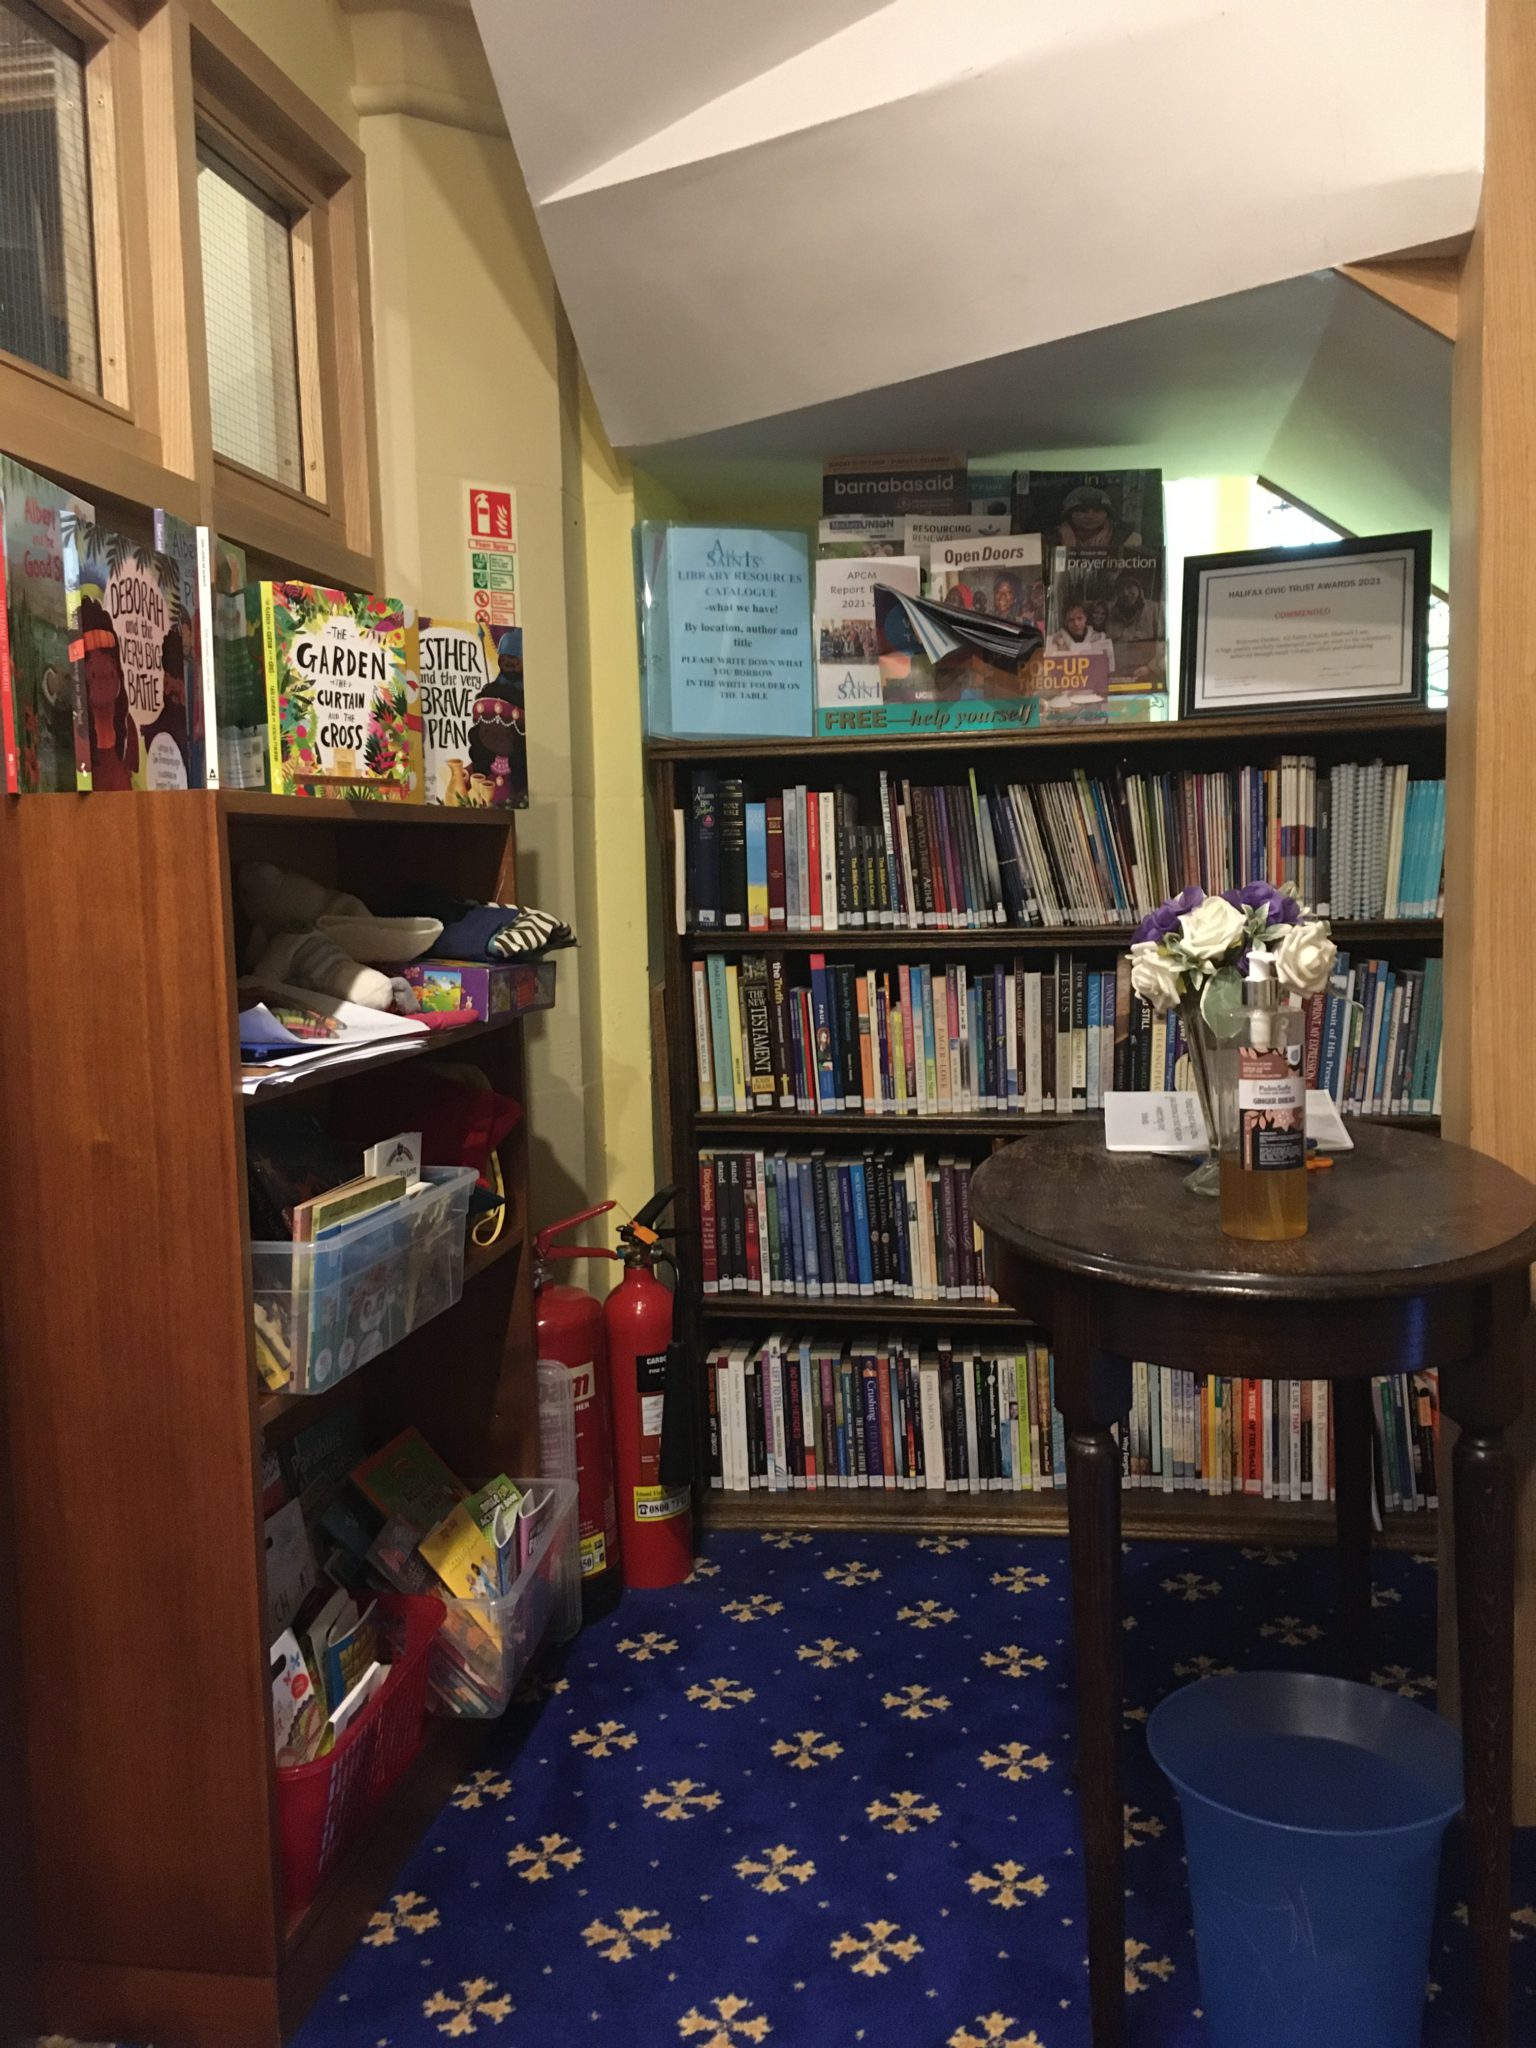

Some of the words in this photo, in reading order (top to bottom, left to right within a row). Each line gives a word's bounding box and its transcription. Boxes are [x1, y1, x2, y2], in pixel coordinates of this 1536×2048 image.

[913, 524, 971, 533] RESOURCING
[945, 549, 980, 566] Open
[982, 546, 1024, 561] Doors
[678, 571, 729, 581] LIBRARY
[734, 571, 802, 584] RESOURCES
[847, 572, 877, 580] APCM
[705, 587, 778, 598] CATALOGUE
[830, 586, 865, 595] Report
[1228, 588, 1263, 599] HALIFAX
[1264, 586, 1286, 595] CIVIC
[1289, 583, 1315, 593] TRUST
[1317, 580, 1356, 591] AWARDS
[1358, 577, 1381, 586] 2021
[111, 577, 164, 631] DEBORAH
[736, 604, 750, 613] we
[752, 604, 778, 614] have!
[126, 618, 139, 636] and
[142, 621, 153, 639] the
[331, 626, 347, 640] THE
[685, 622, 698, 634] By
[701, 622, 743, 634] location,
[746, 625, 777, 635] author
[780, 626, 798, 636] and
[119, 636, 143, 671] VERY
[145, 642, 162, 671] BIG
[734, 638, 752, 648] title
[297, 642, 386, 680] GARDEN
[419, 637, 482, 673] ESTHER
[681, 656, 715, 664] PLEASE
[716, 656, 746, 665] WRITE
[748, 658, 776, 666] DOWN
[777, 659, 803, 668] WHAT
[440, 672, 457, 686] the
[460, 674, 482, 690] very
[734, 668, 772, 677] BORROW
[128, 669, 160, 712] BATTLE
[698, 680, 716, 688] THE
[718, 681, 746, 689] WHITE
[750, 682, 786, 690] FOLDER
[317, 689, 365, 710] CURTAIN
[421, 686, 472, 718] BRAVE
[720, 692, 738, 700] THE
[740, 692, 768, 700] TABLE
[344, 713, 355, 722] THE
[956, 702, 1036, 728] yourself
[320, 723, 363, 750] CROSS
[428, 717, 467, 750] PLAN
[748, 990, 765, 999] THE
[748, 998, 765, 1007] NEW
[1061, 972, 1070, 1013] JESUS
[1090, 982, 1098, 1021] YANCEY
[1105, 982, 1114, 1019] YANCEY
[1141, 1008, 1150, 1030] STILL
[751, 1006, 771, 1072] TESTAMENT
[1328, 1028, 1335, 1038] of
[1306, 1039, 1319, 1080] EXPRESSION
[1327, 1042, 1335, 1057] His
[940, 1064, 948, 1089] LOVE
[702, 1168, 712, 1211] Discipleship
[867, 1166, 875, 1192] SOUL
[877, 1172, 885, 1196] SOUL
[856, 1194, 864, 1219] GUMBEL
[773, 1385, 780, 1394] TO
[866, 1380, 877, 1421] Crushing
[870, 1441, 879, 1470] JAKES
[649, 1503, 669, 1513] 0800
